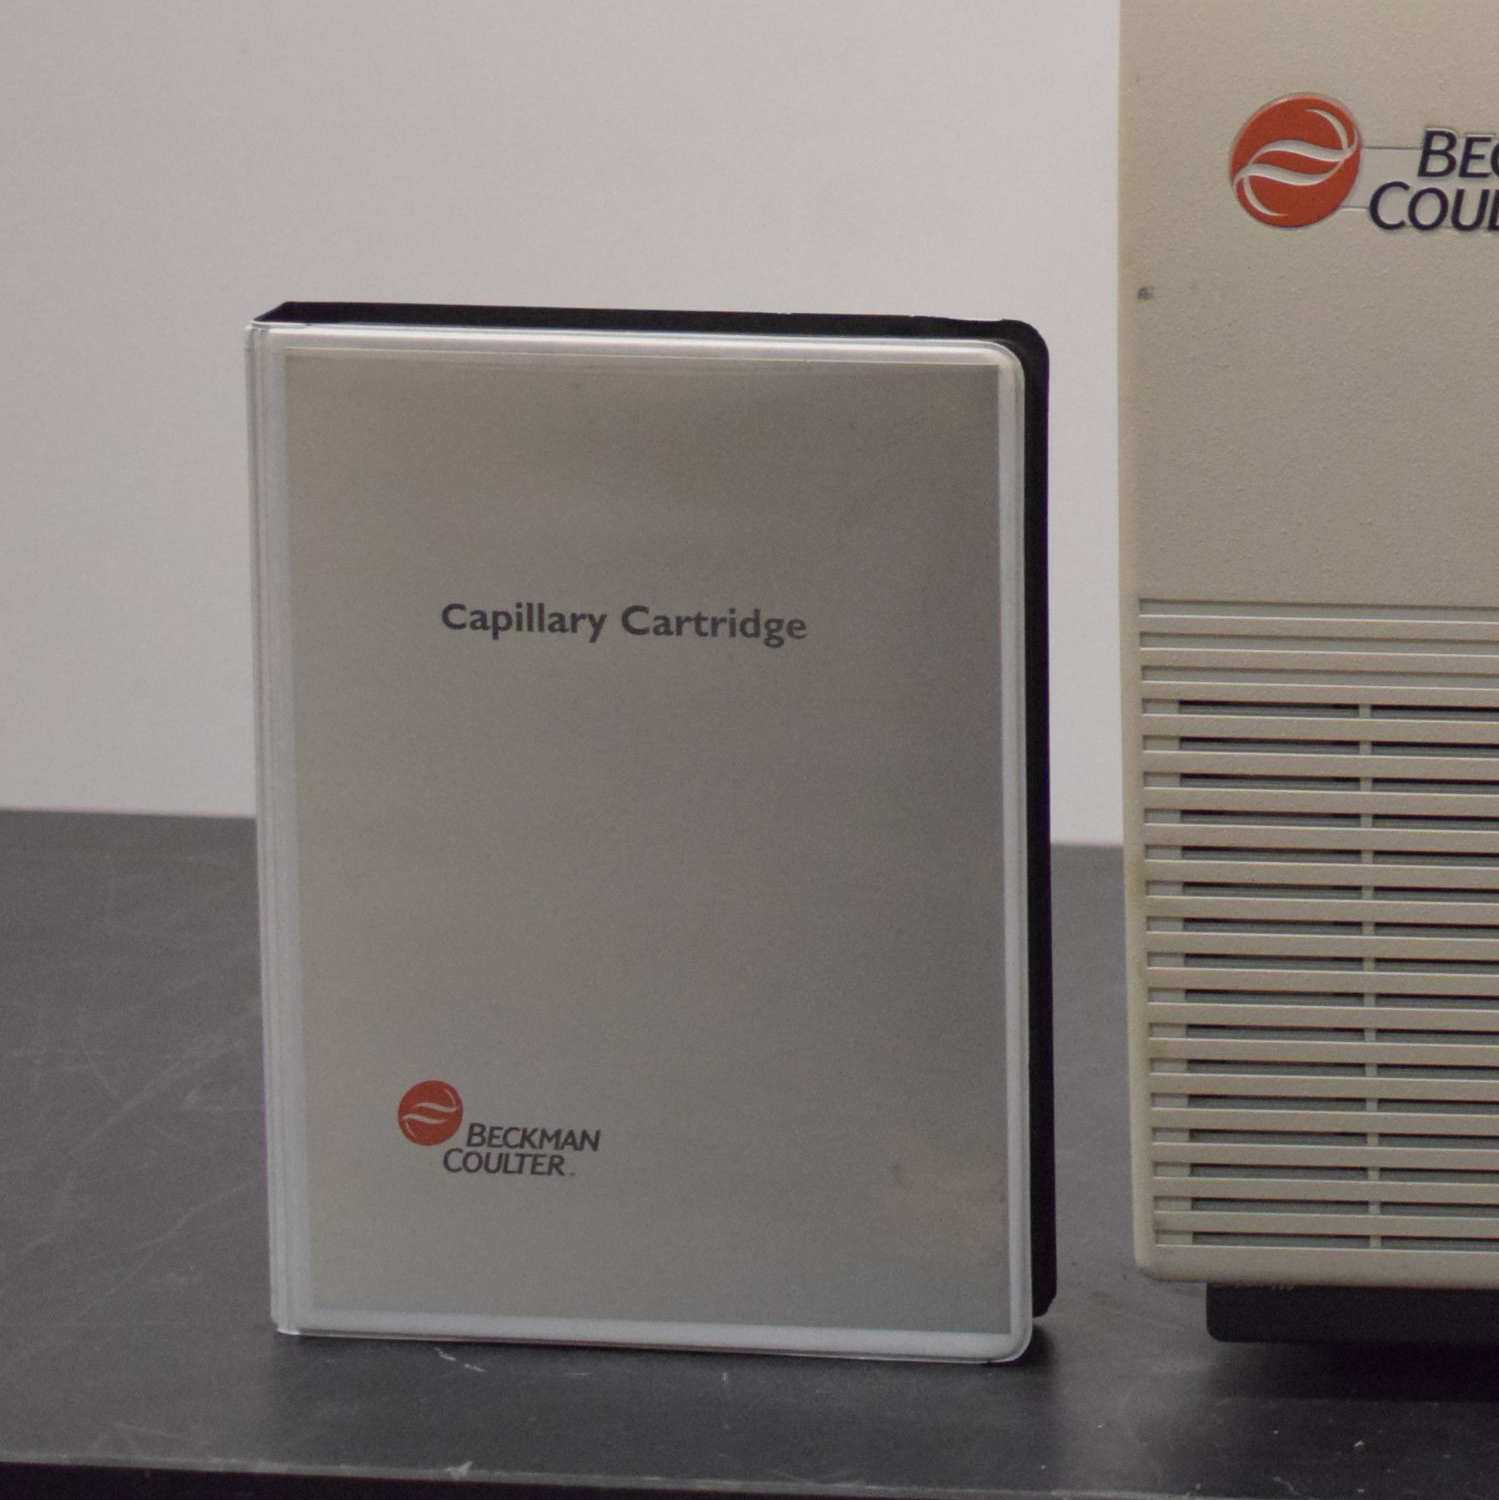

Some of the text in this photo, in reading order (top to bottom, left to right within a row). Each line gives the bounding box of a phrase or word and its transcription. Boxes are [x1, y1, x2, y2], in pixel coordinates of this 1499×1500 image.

[441, 602, 808, 648] Capillary Cartridge
[466, 1122, 600, 1152] BECKMAN
[443, 1148, 565, 1177] COULTER
